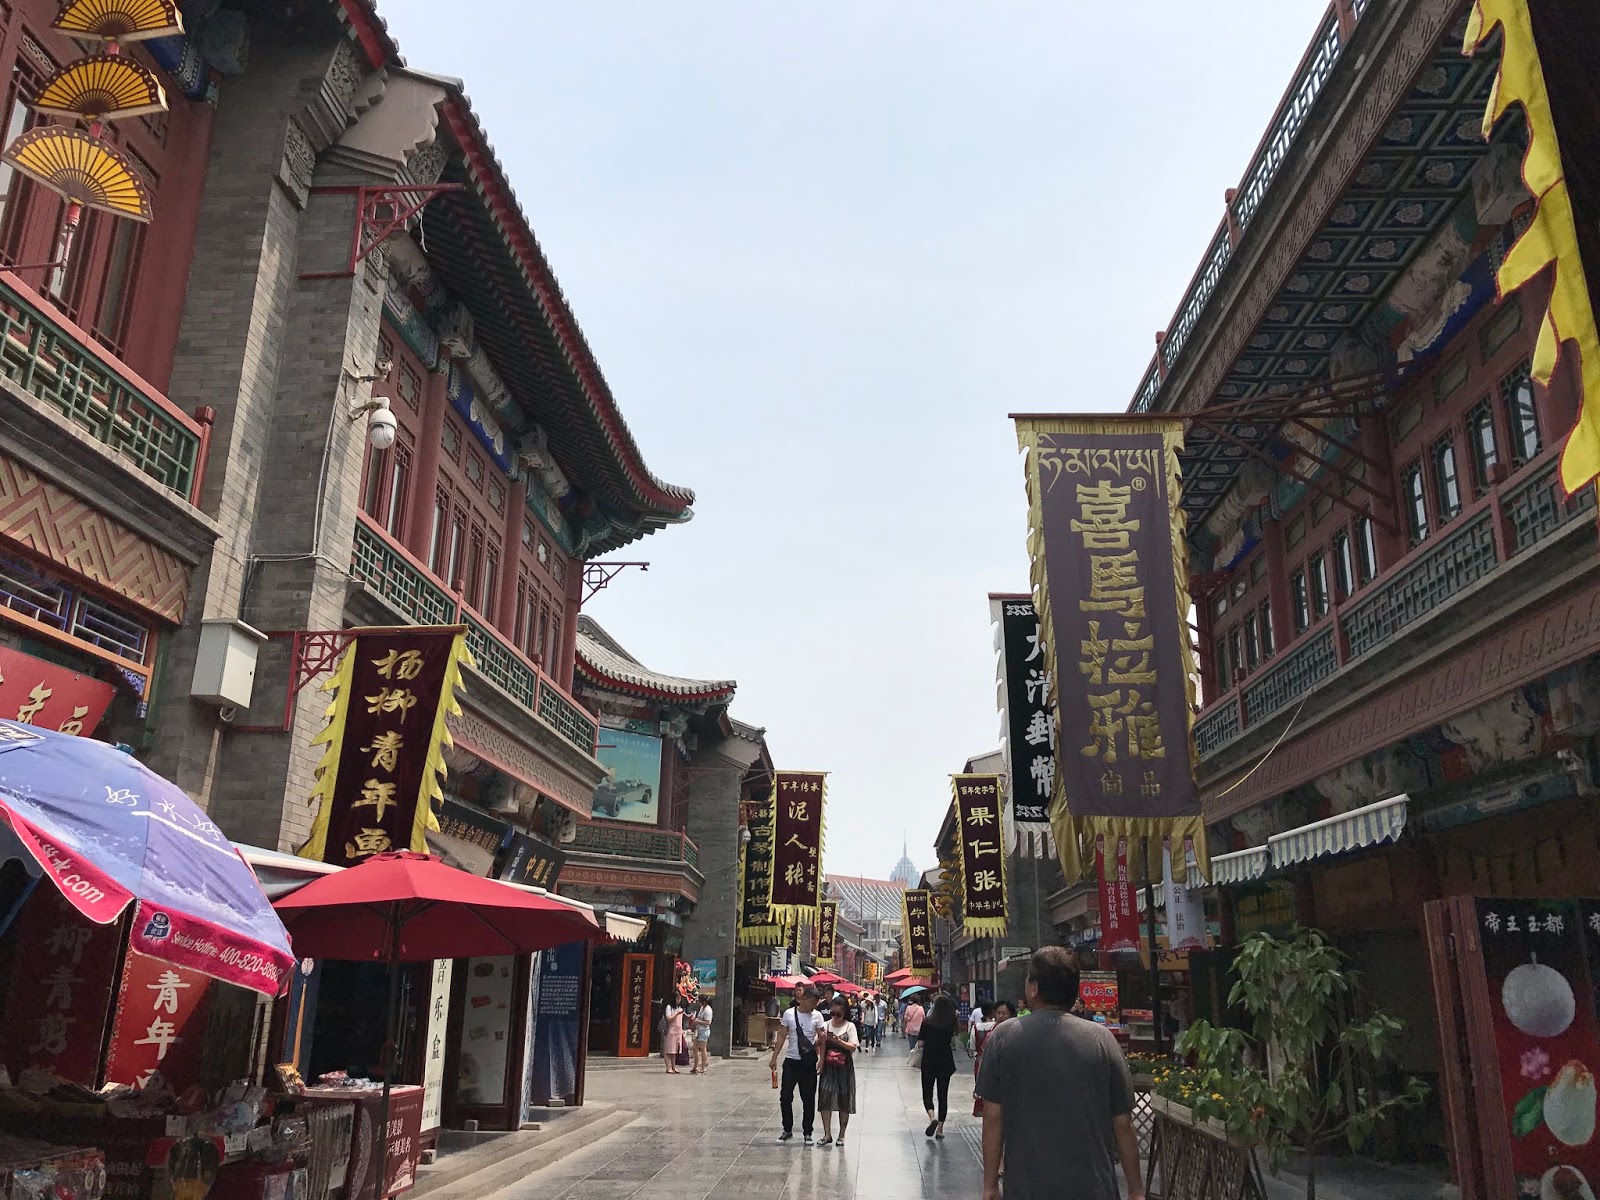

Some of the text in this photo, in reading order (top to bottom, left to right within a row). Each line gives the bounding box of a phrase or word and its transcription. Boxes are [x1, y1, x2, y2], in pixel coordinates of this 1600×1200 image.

[781, 781, 820, 793] 百年传承
[967, 806, 1002, 892] 果仁张
[171, 930, 195, 949] Service
